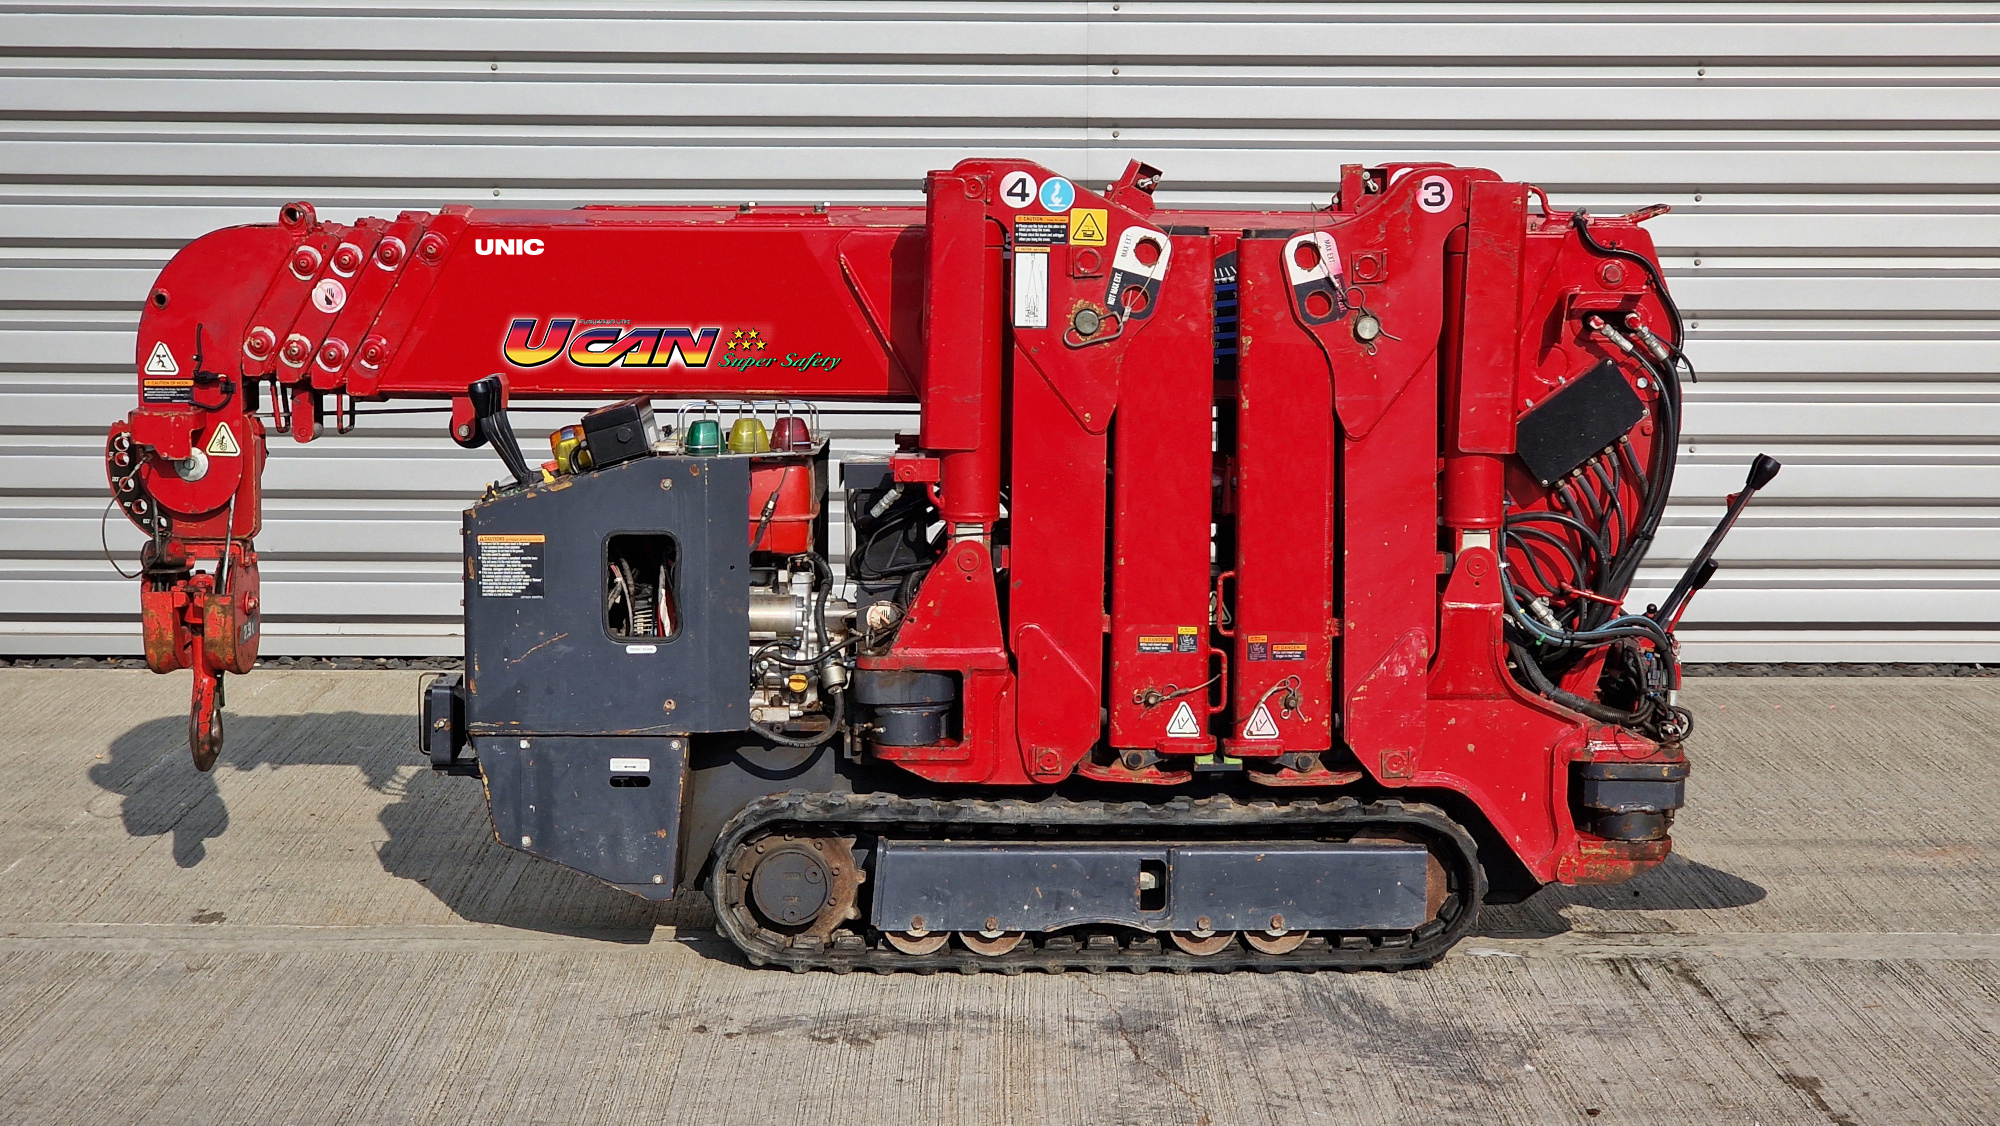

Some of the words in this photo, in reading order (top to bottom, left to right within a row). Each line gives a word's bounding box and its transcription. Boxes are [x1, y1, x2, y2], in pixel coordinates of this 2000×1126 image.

[1006, 177, 1030, 202] 4
[1423, 181, 1446, 207] 3
[475, 239, 545, 255] UNIC
[1120, 245, 1130, 258] MAX
[1324, 239, 1332, 252] MAX
[1110, 281, 1121, 294] MAX
[503, 318, 721, 368] UCAN
[718, 352, 778, 372] Super
[780, 351, 842, 372] Safety
